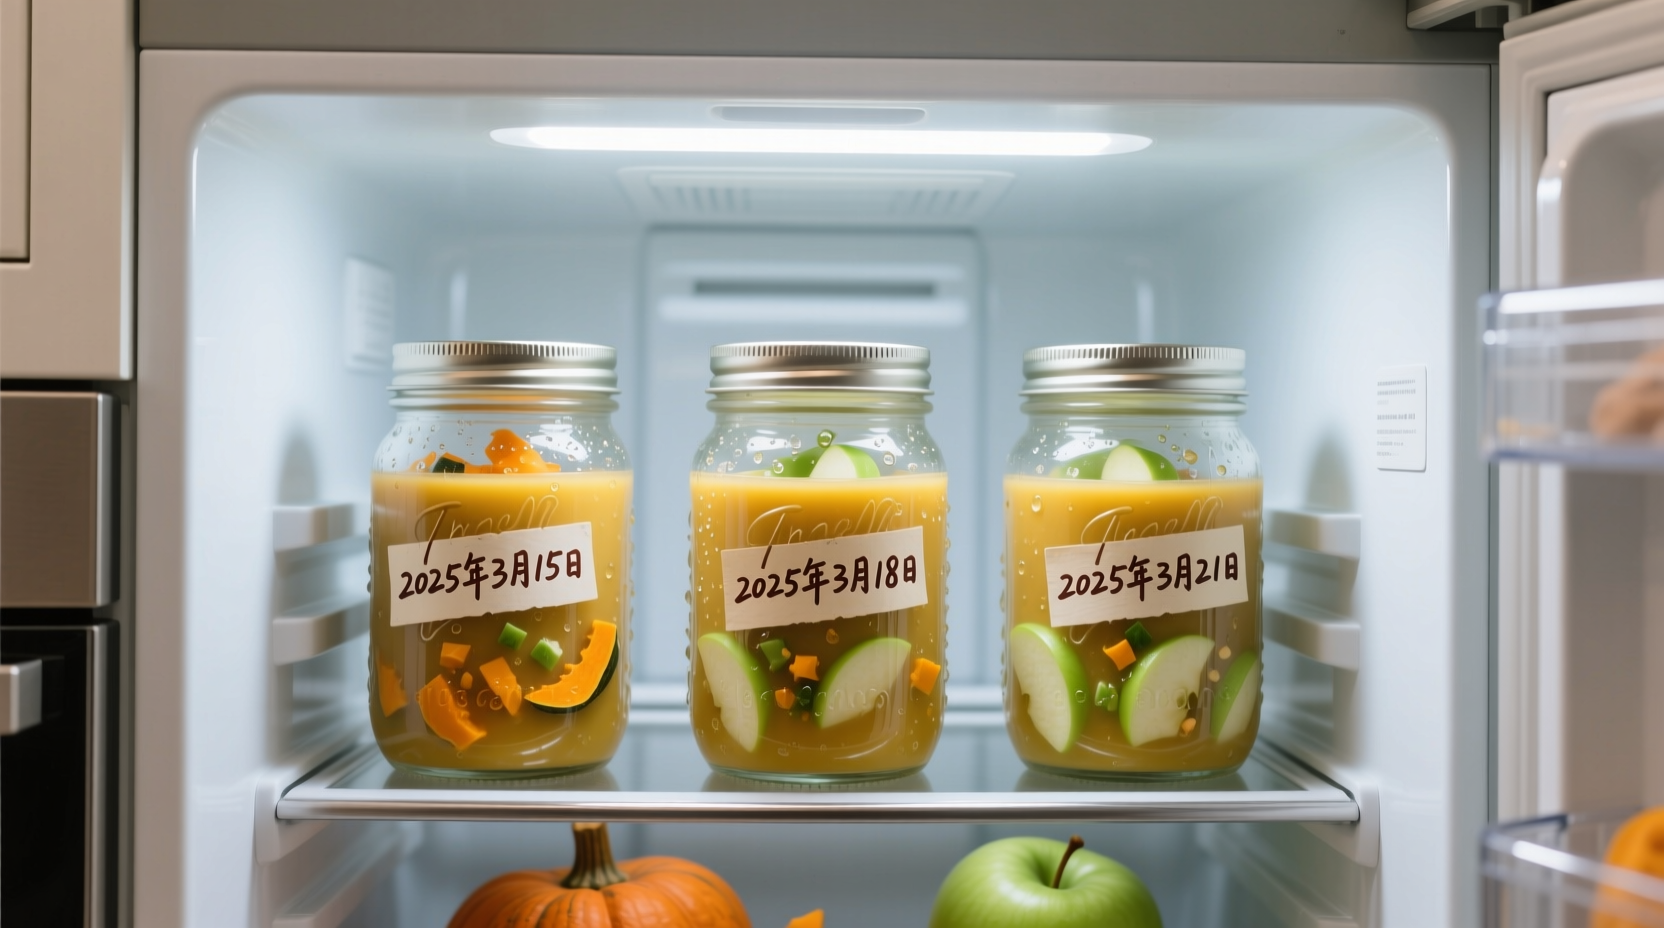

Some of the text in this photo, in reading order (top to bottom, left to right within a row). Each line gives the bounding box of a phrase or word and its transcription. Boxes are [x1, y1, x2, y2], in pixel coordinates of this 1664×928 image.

[399, 549, 581, 601] 2025年3月15日
[734, 554, 916, 606] 2025年3月18日
[1057, 552, 1239, 602] 2025年3月21日
